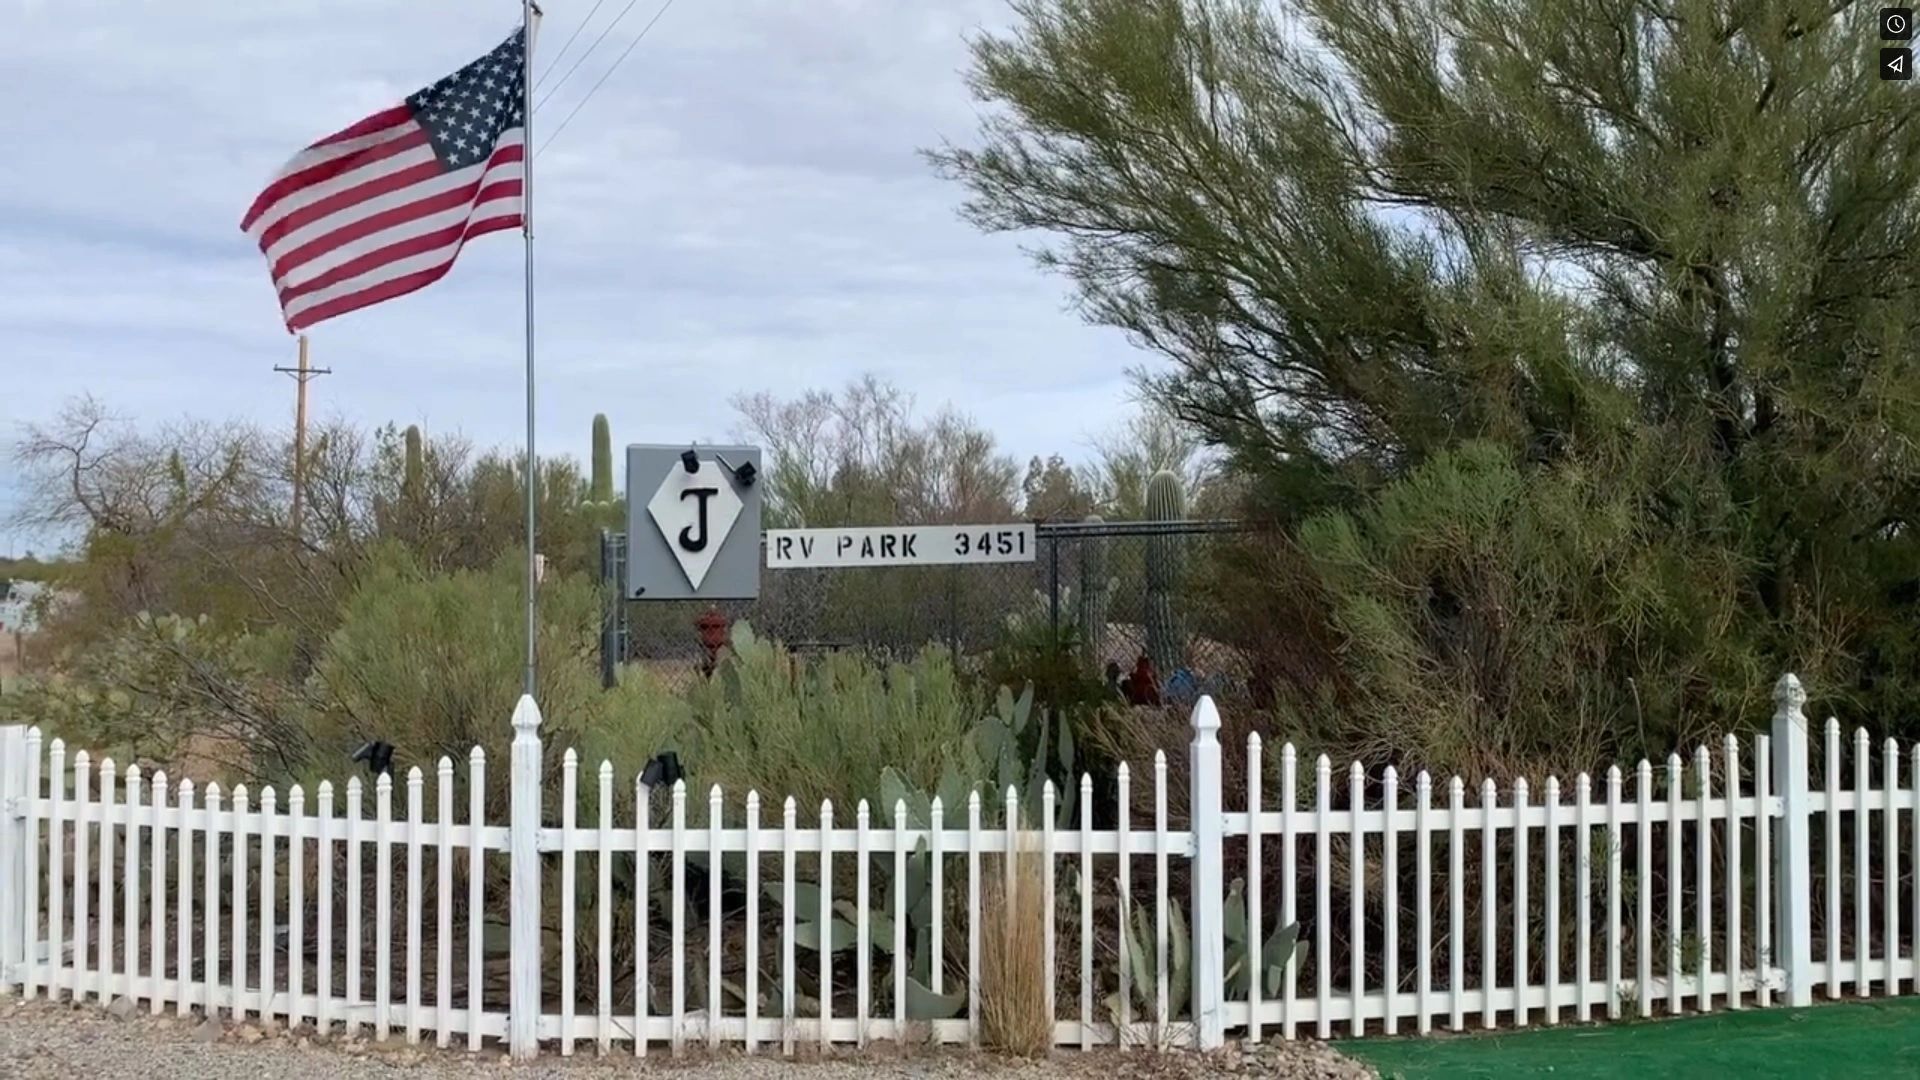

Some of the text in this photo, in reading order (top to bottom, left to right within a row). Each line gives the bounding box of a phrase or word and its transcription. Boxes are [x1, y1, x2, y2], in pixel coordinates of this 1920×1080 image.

[678, 487, 719, 553] J
[776, 530, 1025, 560] RV PARK 3451
